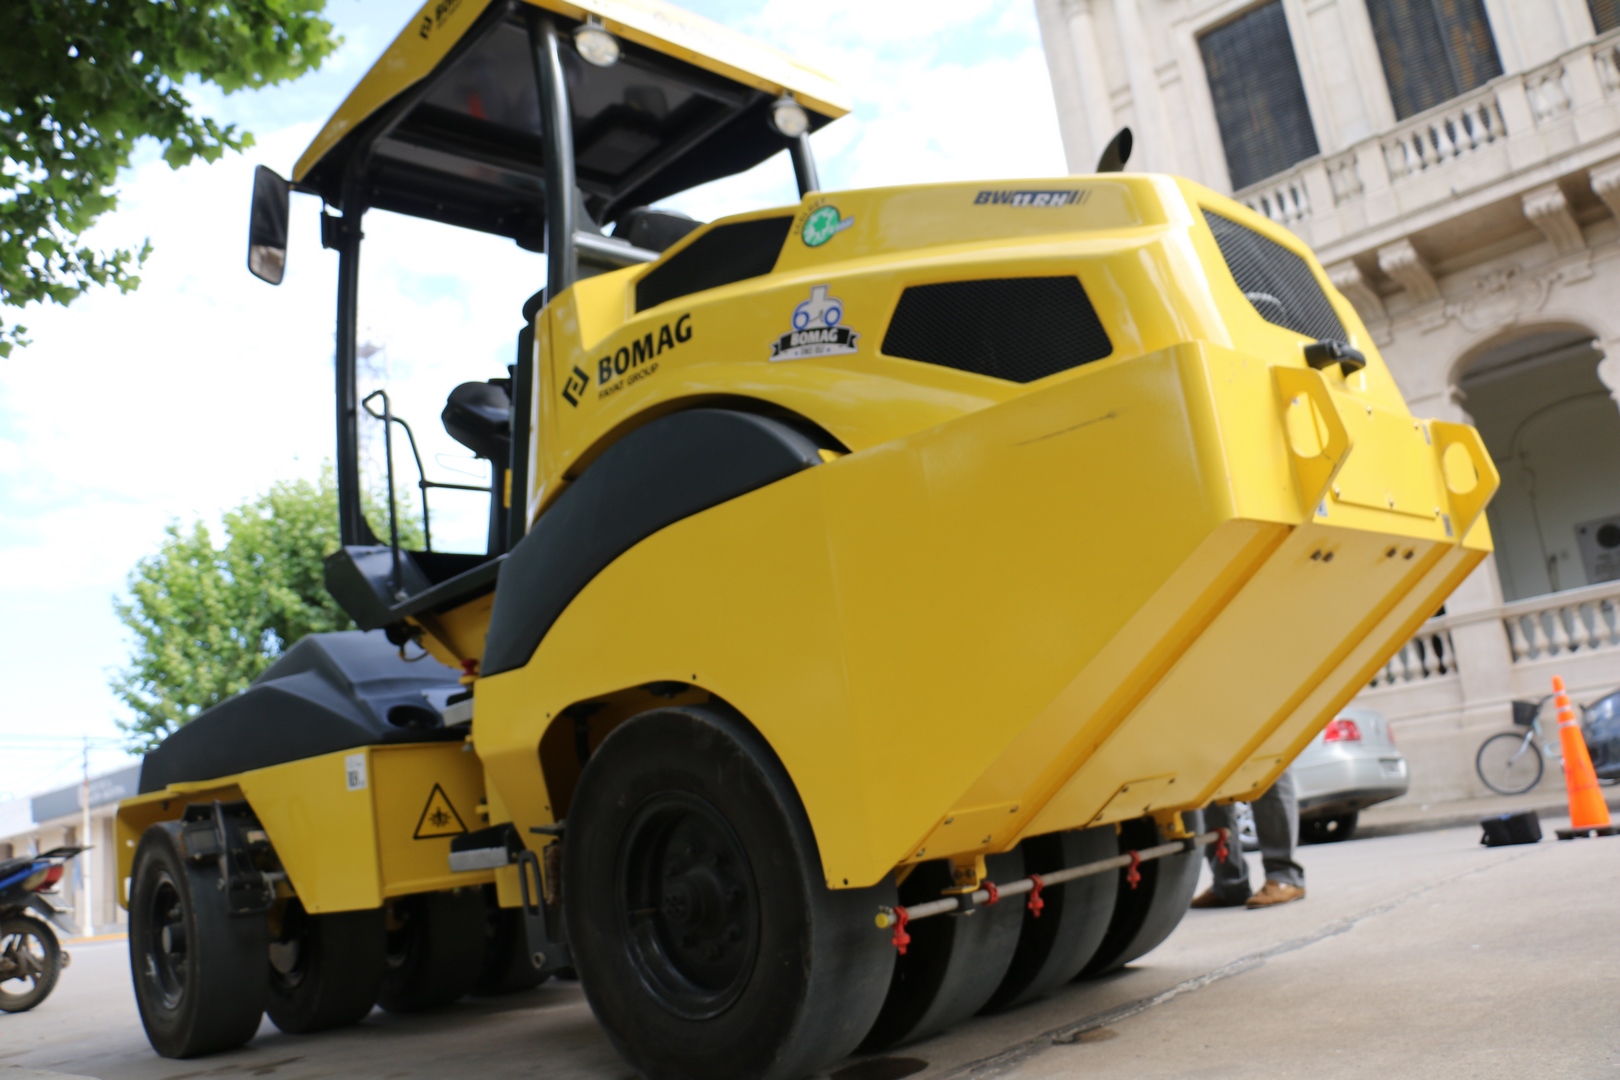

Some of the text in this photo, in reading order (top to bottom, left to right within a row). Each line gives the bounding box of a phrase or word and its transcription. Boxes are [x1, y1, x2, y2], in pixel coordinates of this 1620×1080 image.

[598, 312, 692, 385] BOMAG
[790, 328, 839, 347] BOMAG
[626, 362, 659, 386] GROUP
